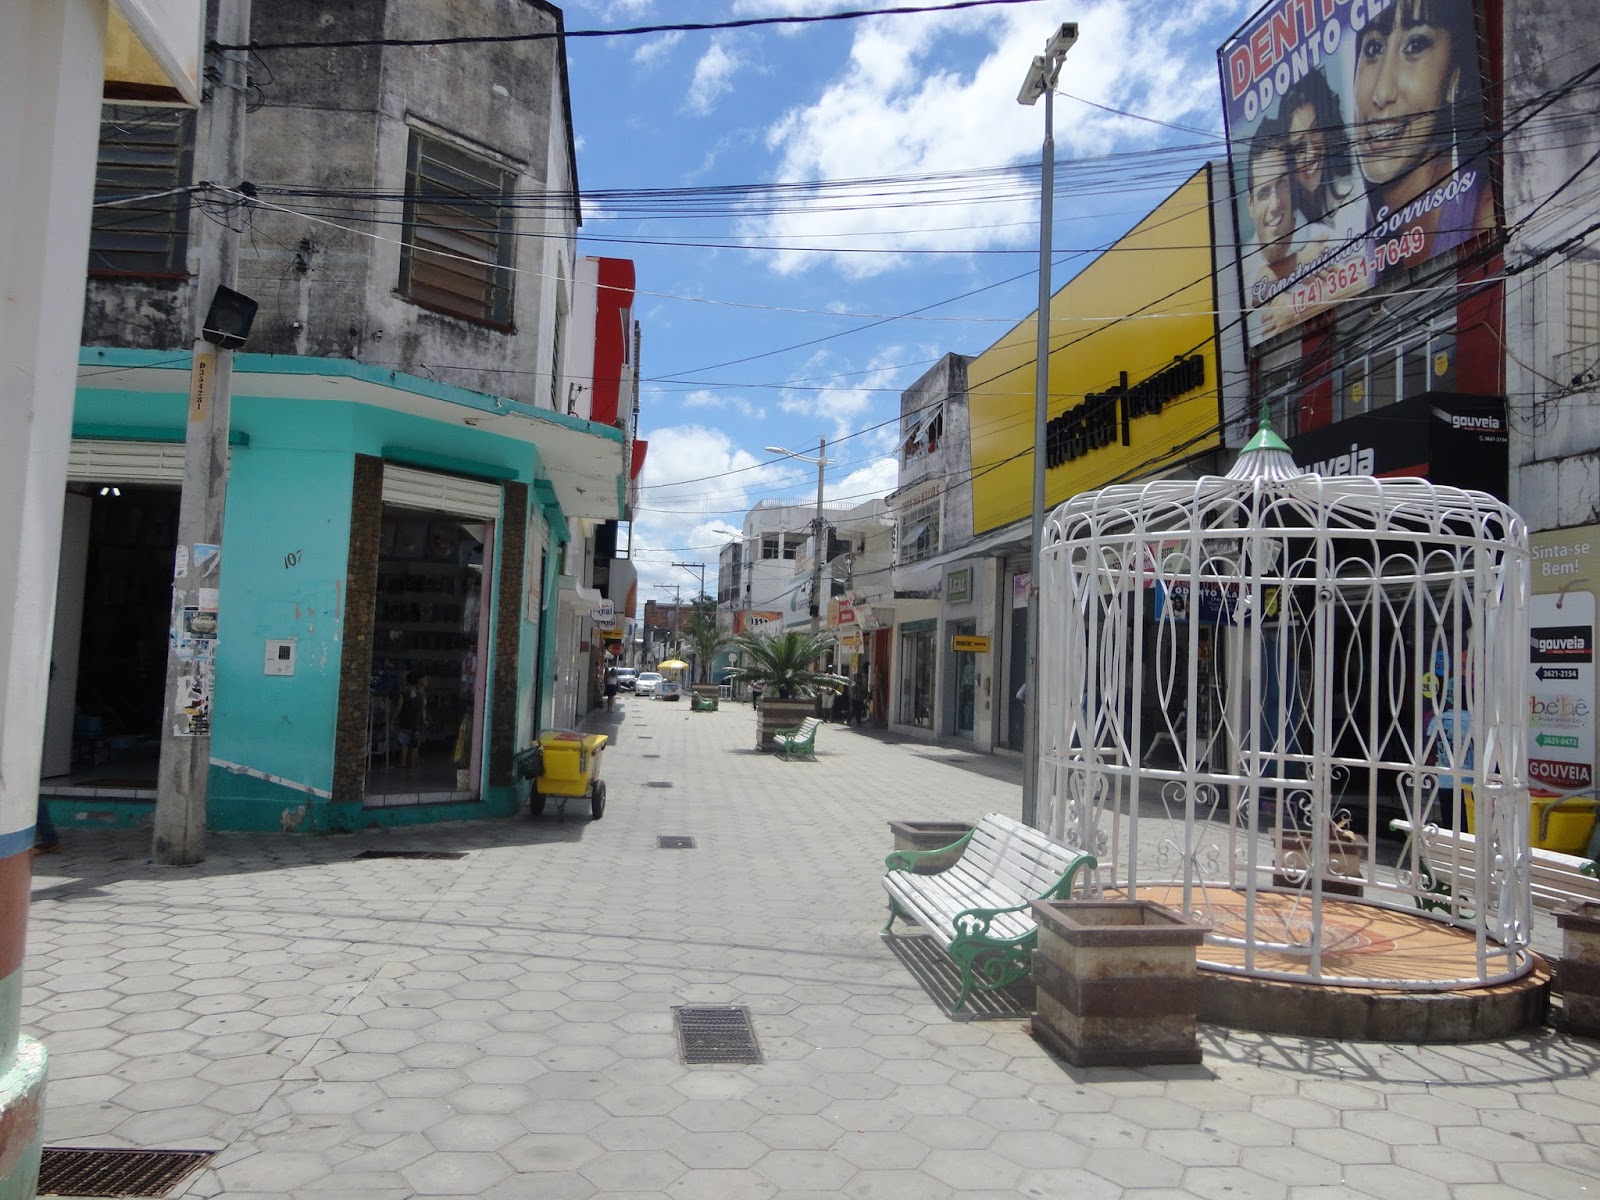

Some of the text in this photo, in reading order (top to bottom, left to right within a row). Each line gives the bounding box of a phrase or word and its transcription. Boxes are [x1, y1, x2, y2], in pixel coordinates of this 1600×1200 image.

[1229, 0, 1349, 101] DENTI
[1244, 18, 1341, 121] ODONTO
[1373, 171, 1477, 240] Sorrisos
[1291, 226, 1425, 317] (74) 3621-7649
[1452, 415, 1501, 429] gouveia
[283, 549, 304, 570] 107
[1531, 543, 1590, 560] Sinta-se
[1542, 558, 1579, 576] Bem!
[1174, 587, 1218, 597] ODNTO
[1538, 635, 1585, 653] gouveia
[1543, 670, 1577, 678] 3621-2154
[1529, 761, 1590, 782] GOUVEIA
